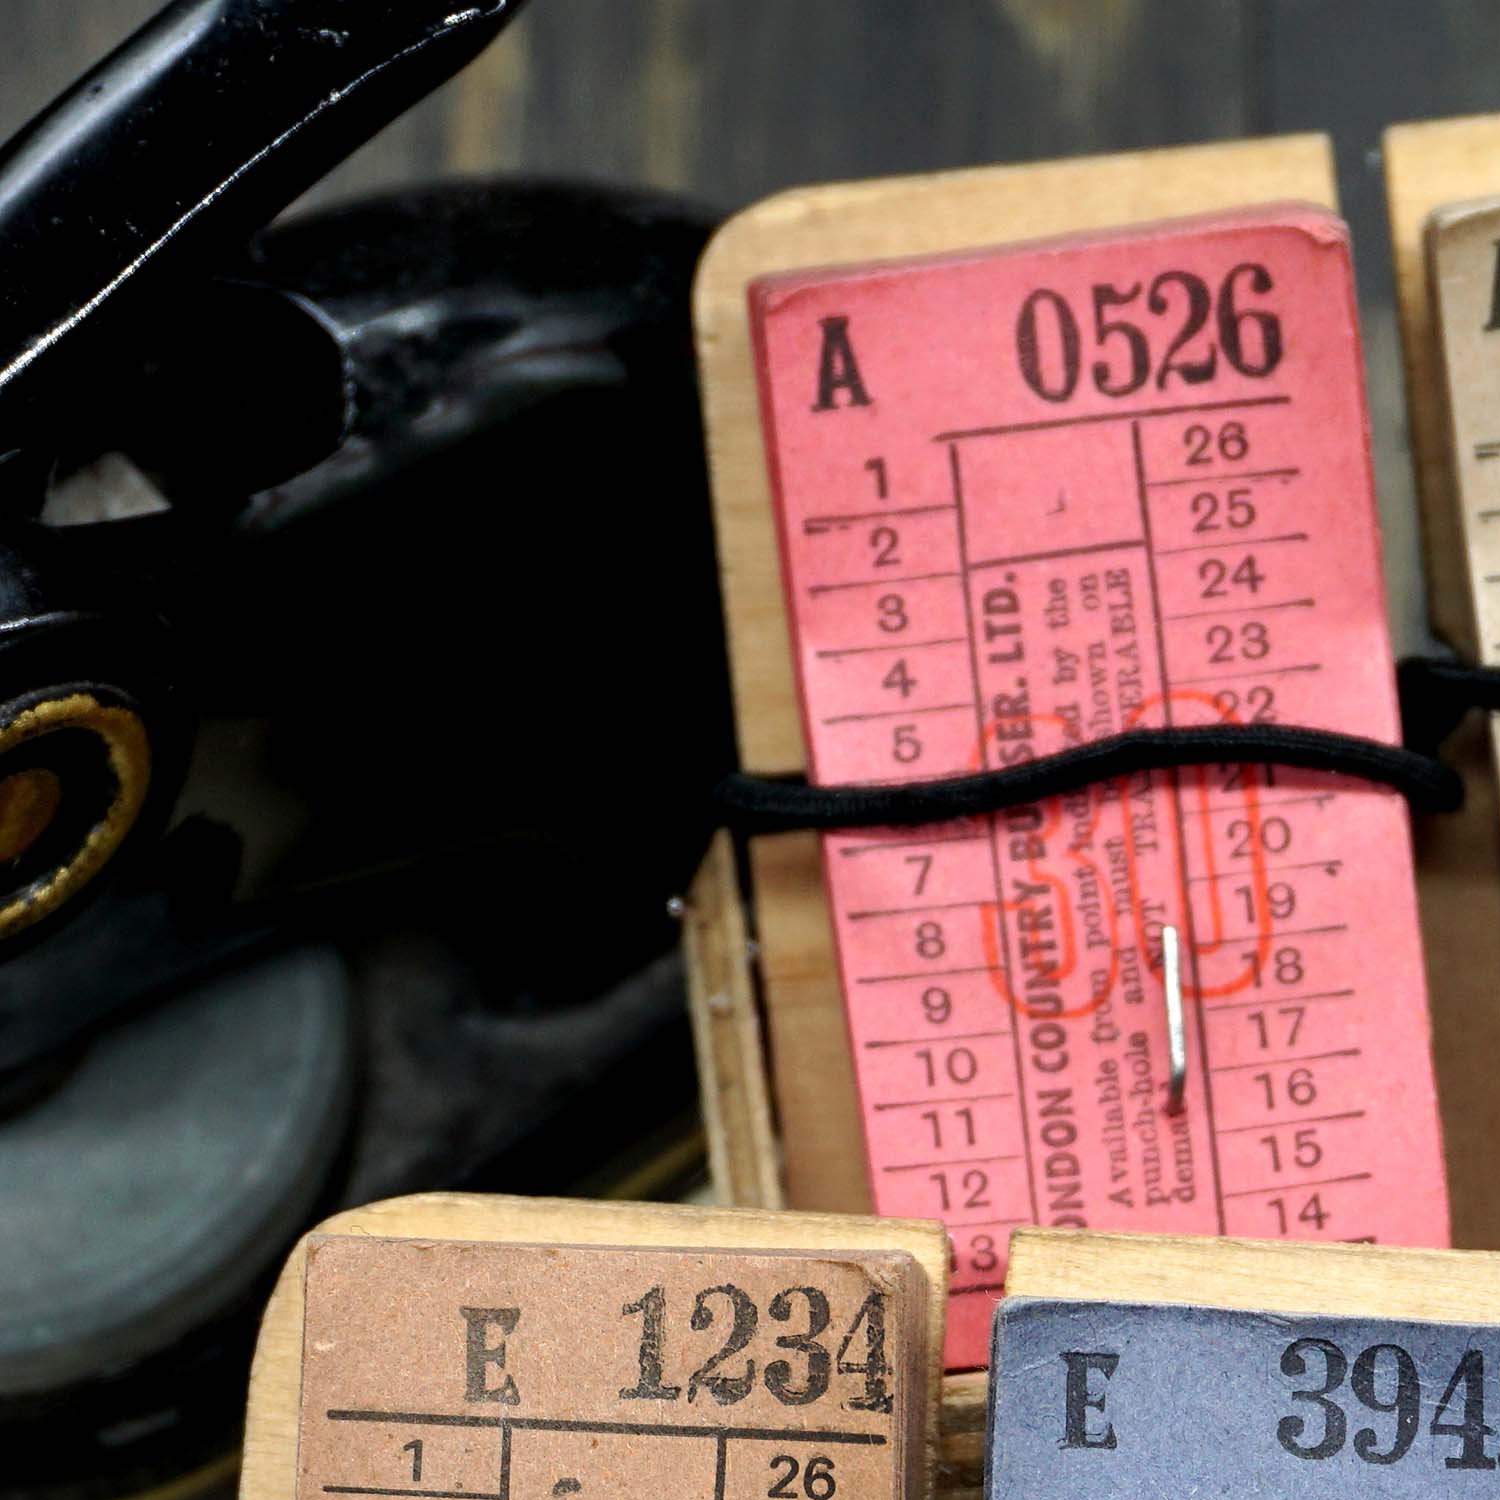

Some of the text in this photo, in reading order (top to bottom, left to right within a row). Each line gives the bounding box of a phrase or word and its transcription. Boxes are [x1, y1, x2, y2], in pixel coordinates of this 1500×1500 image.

[813, 263, 1284, 412] A 0526
[1184, 422, 1249, 466] 26
[864, 457, 888, 499] 1
[1191, 489, 1256, 534] 25
[870, 525, 900, 568] 2
[1198, 555, 1265, 599] 24
[983, 572, 1070, 1074] COUNTRY LTD.
[1044, 578, 1134, 1208] Available by the
[1117, 946, 1170, 1205] punch-hole and
[1261, 1129, 1323, 1172] 15
[930, 1169, 990, 1211] 12
[1269, 1194, 1329, 1234] 14
[459, 1279, 894, 1416] E 1234
[1061, 1352, 1120, 1450] E
[403, 1439, 423, 1481] 1
